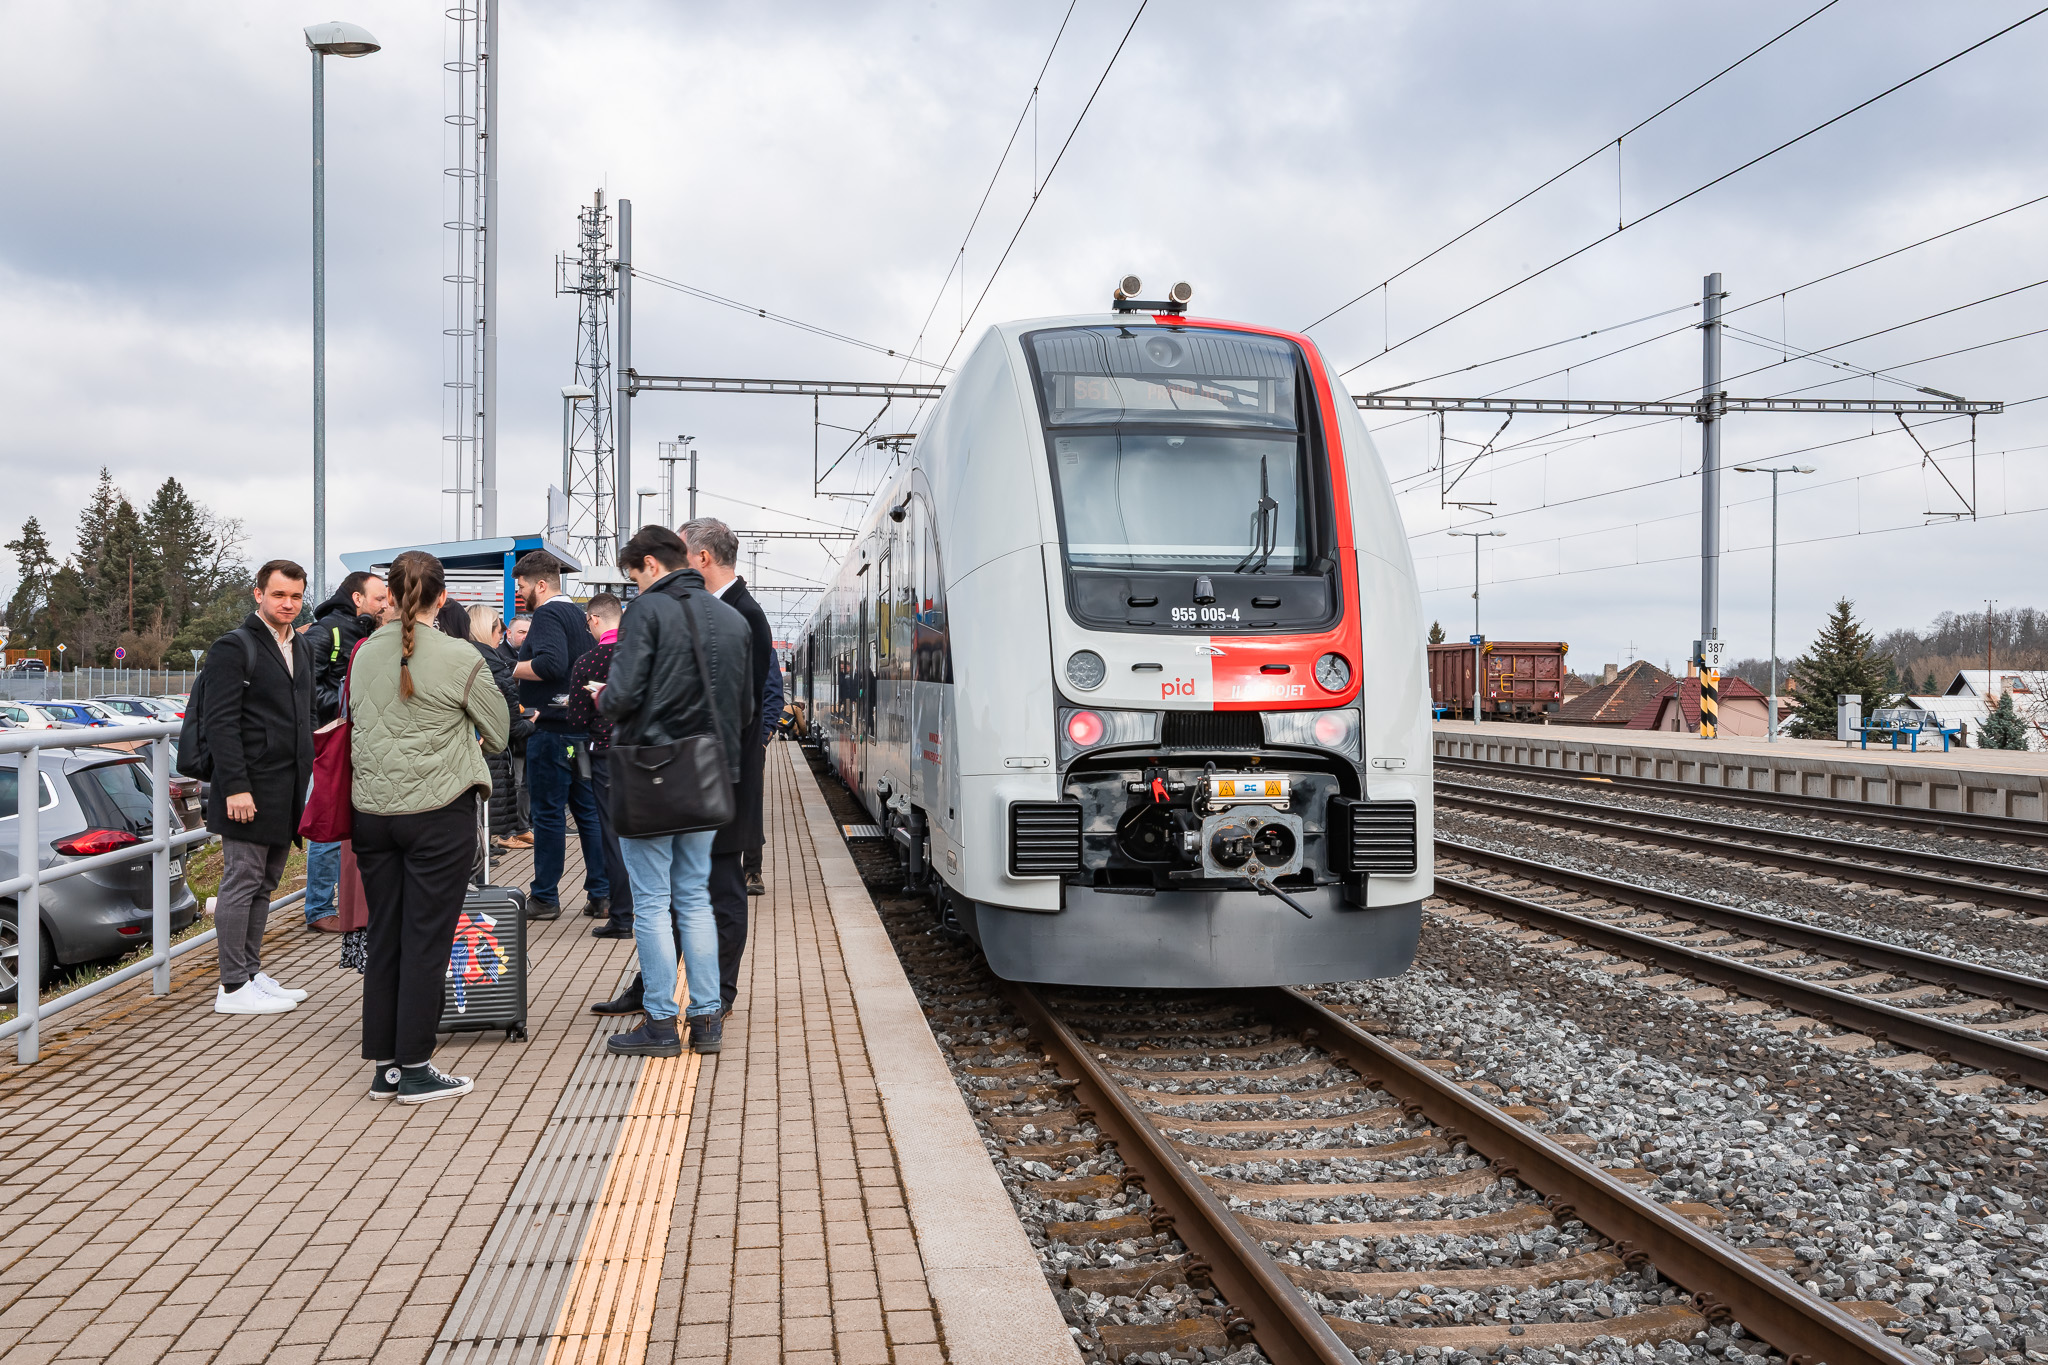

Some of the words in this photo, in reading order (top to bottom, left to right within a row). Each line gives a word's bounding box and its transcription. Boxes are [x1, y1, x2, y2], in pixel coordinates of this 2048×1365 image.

[1075, 380, 1109, 400] S61
[1171, 607, 1197, 621] 955
[1201, 607, 1240, 621] 005-4
[1708, 643, 1724, 653] 387
[1713, 654, 1719, 664] 8
[1161, 677, 1195, 700] pid
